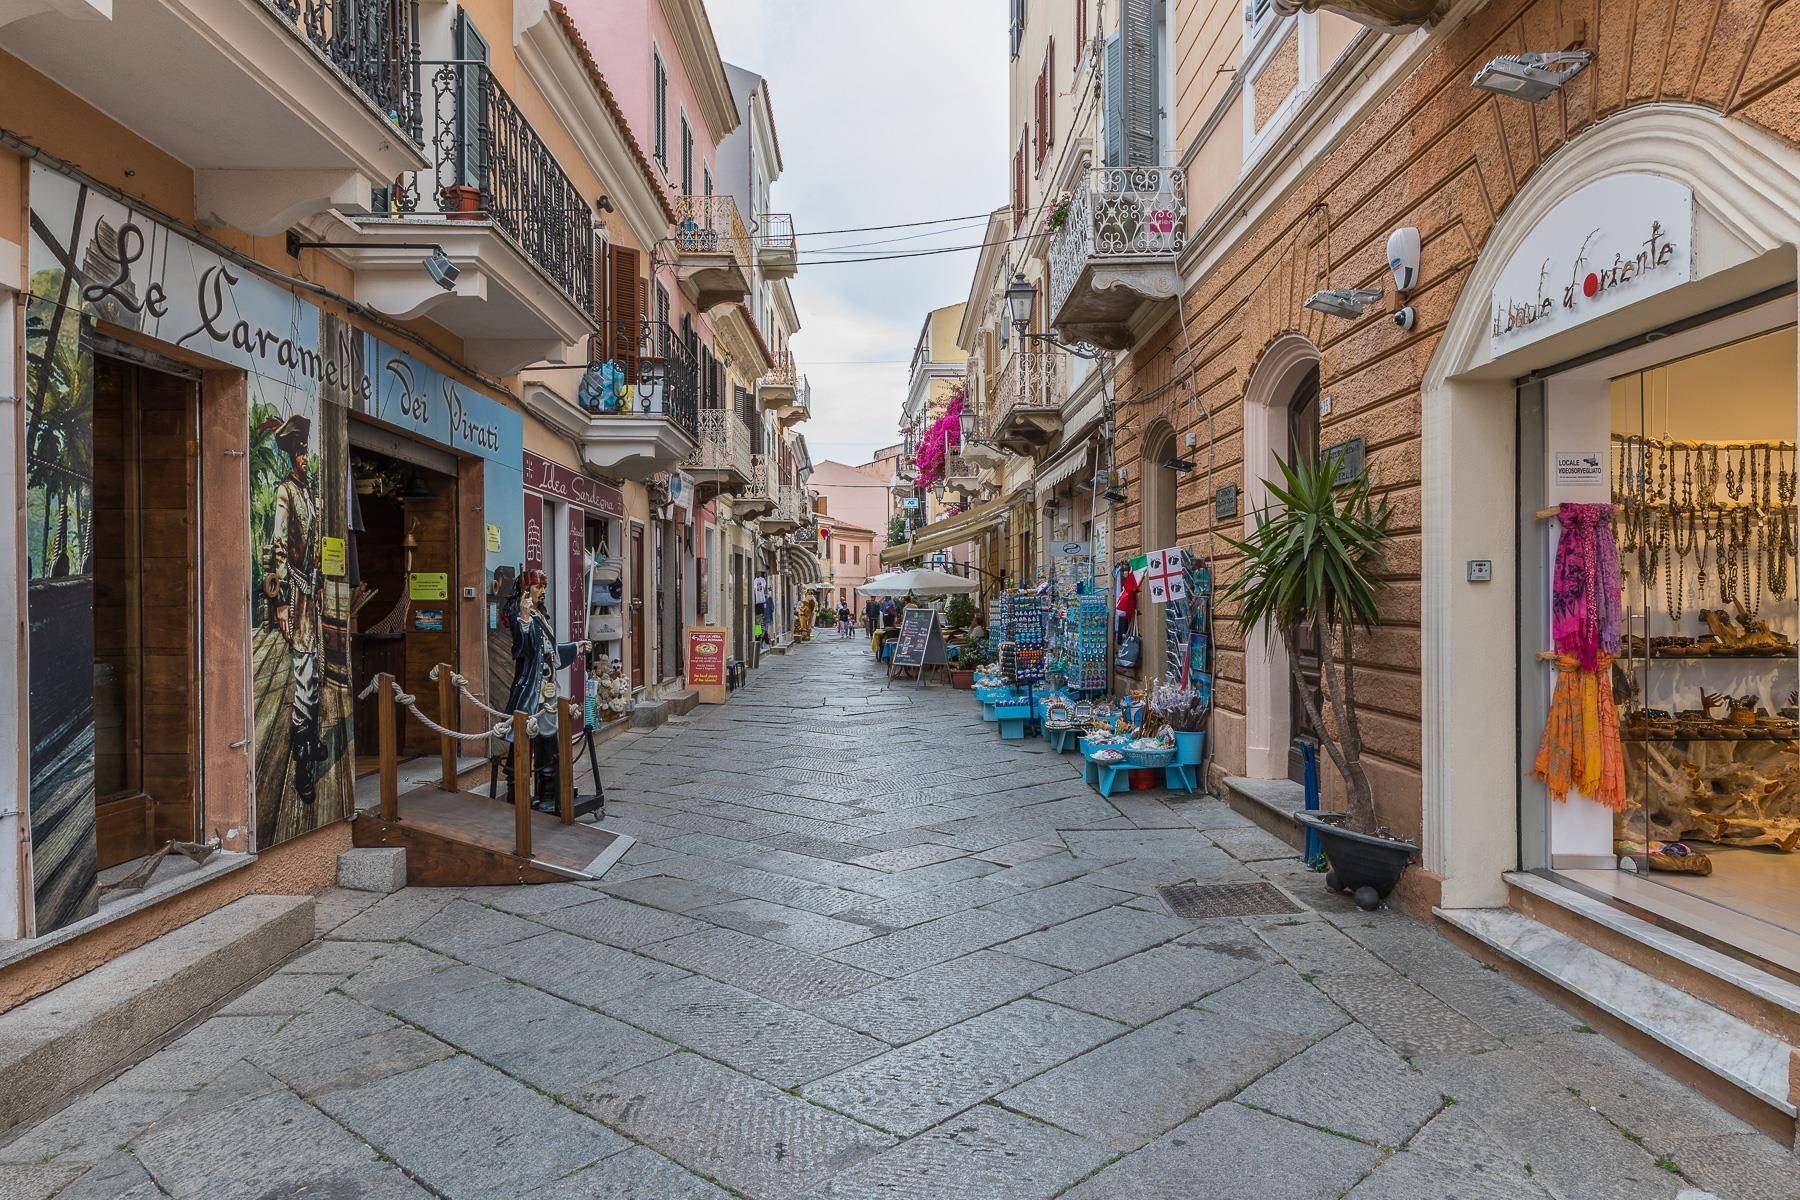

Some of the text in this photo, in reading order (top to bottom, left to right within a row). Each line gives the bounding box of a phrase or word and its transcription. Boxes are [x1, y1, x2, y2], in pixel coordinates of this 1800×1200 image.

[83, 214, 168, 318] Le
[176, 265, 372, 400] Caramelle
[442, 377, 499, 452] Pirati
[539, 461, 614, 511] Idea Sardegna
